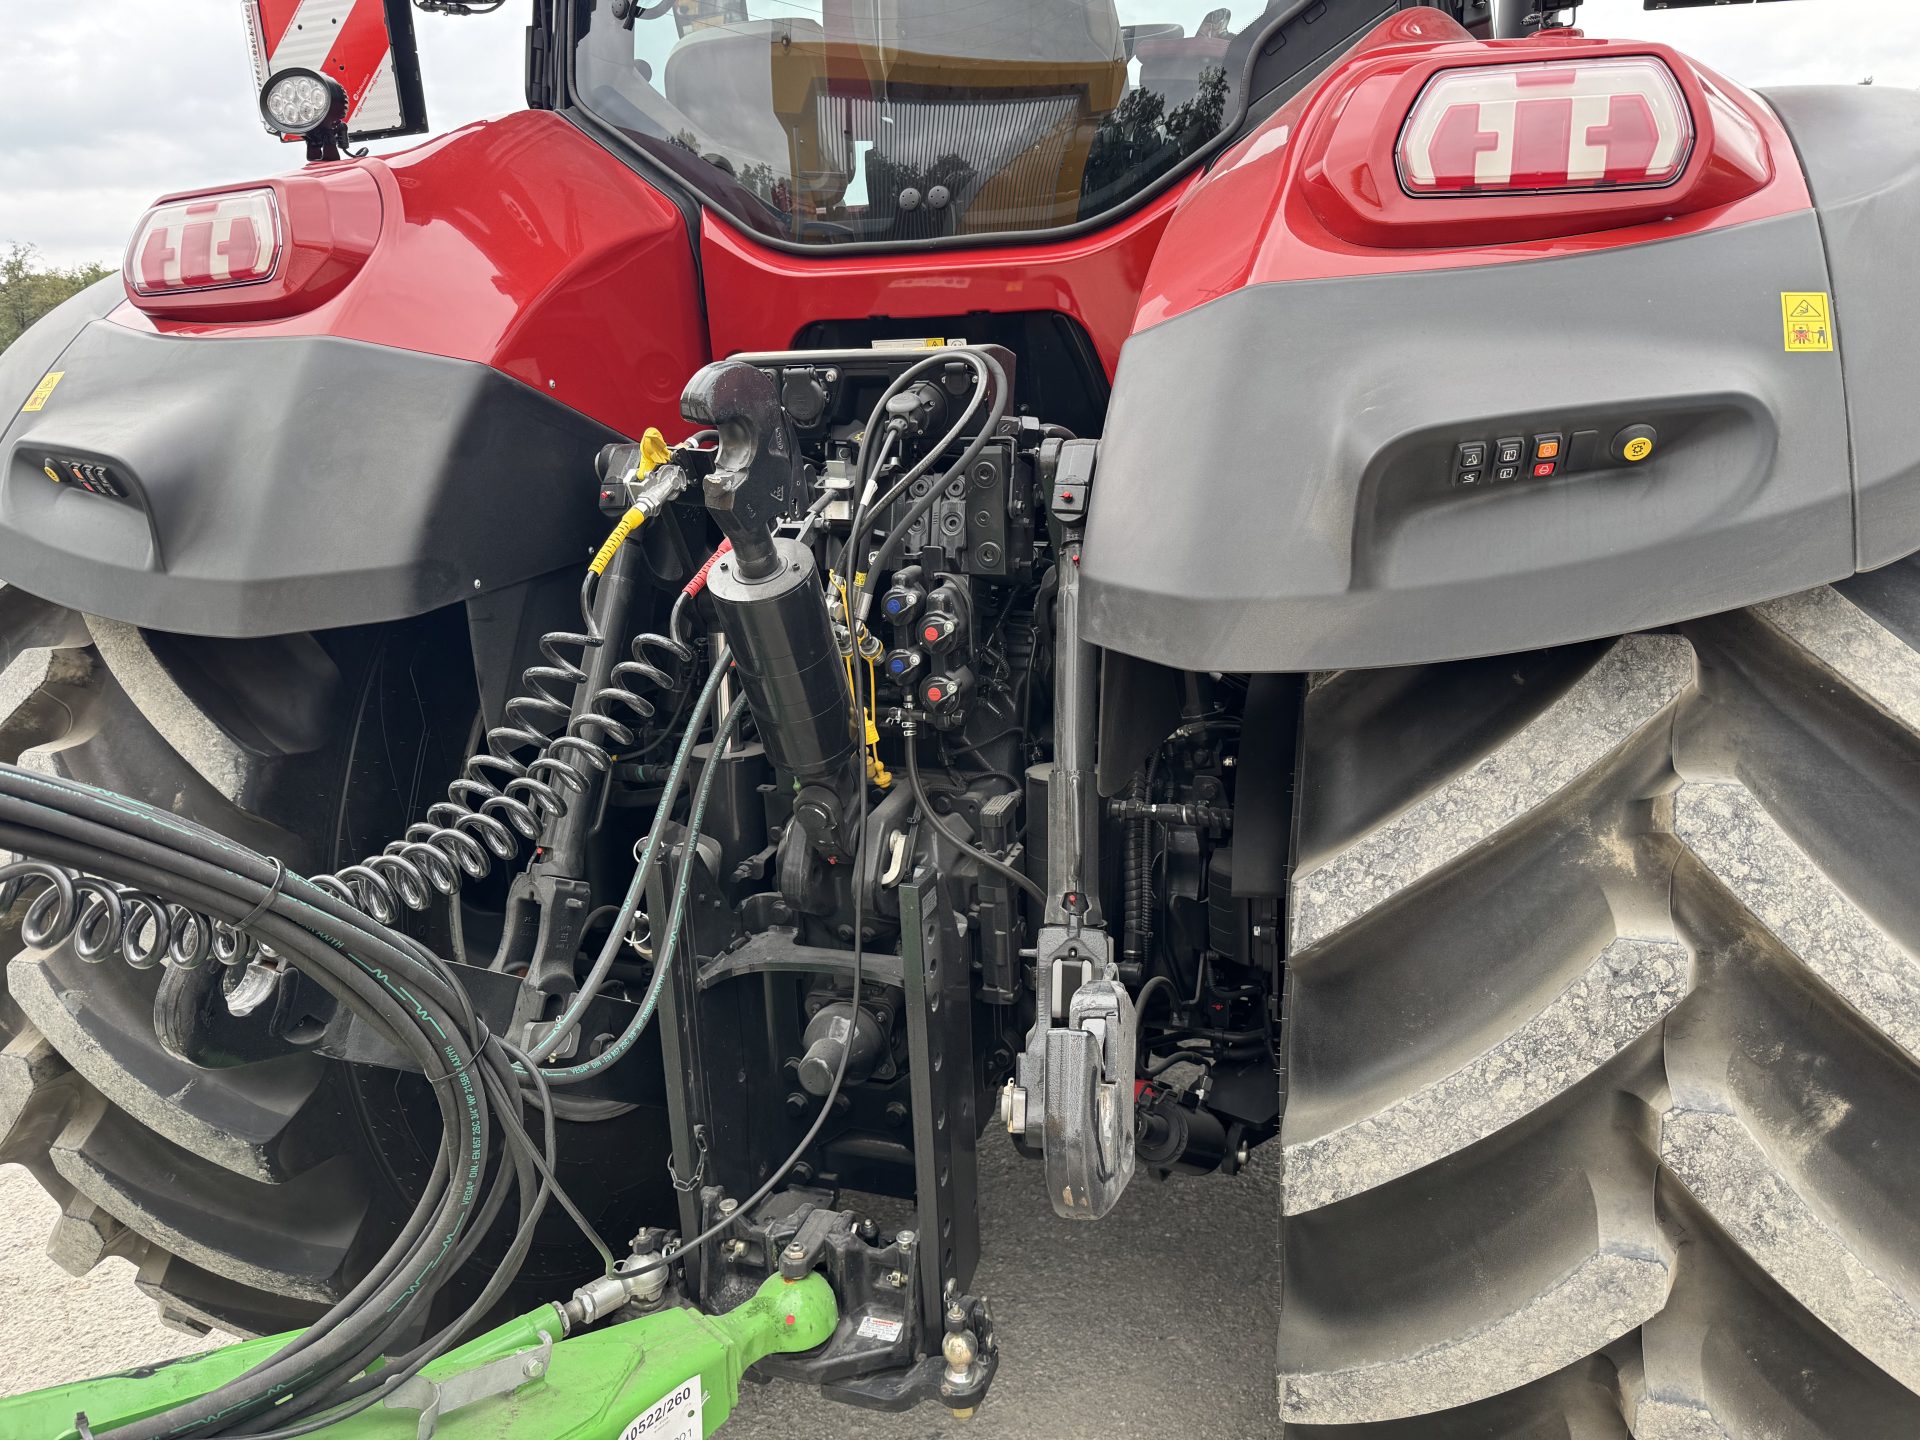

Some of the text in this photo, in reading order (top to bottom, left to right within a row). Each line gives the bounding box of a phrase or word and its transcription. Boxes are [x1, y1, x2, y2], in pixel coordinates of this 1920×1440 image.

[591, 1060, 602, 1069] DIN
[603, 1054, 613, 1063] EN
[466, 1094, 477, 1106] WP
[471, 1120, 481, 1136] 2SC
[472, 1137, 481, 1149] 857
[471, 1149, 480, 1160] EN
[461, 1181, 476, 1205] VEGA®
